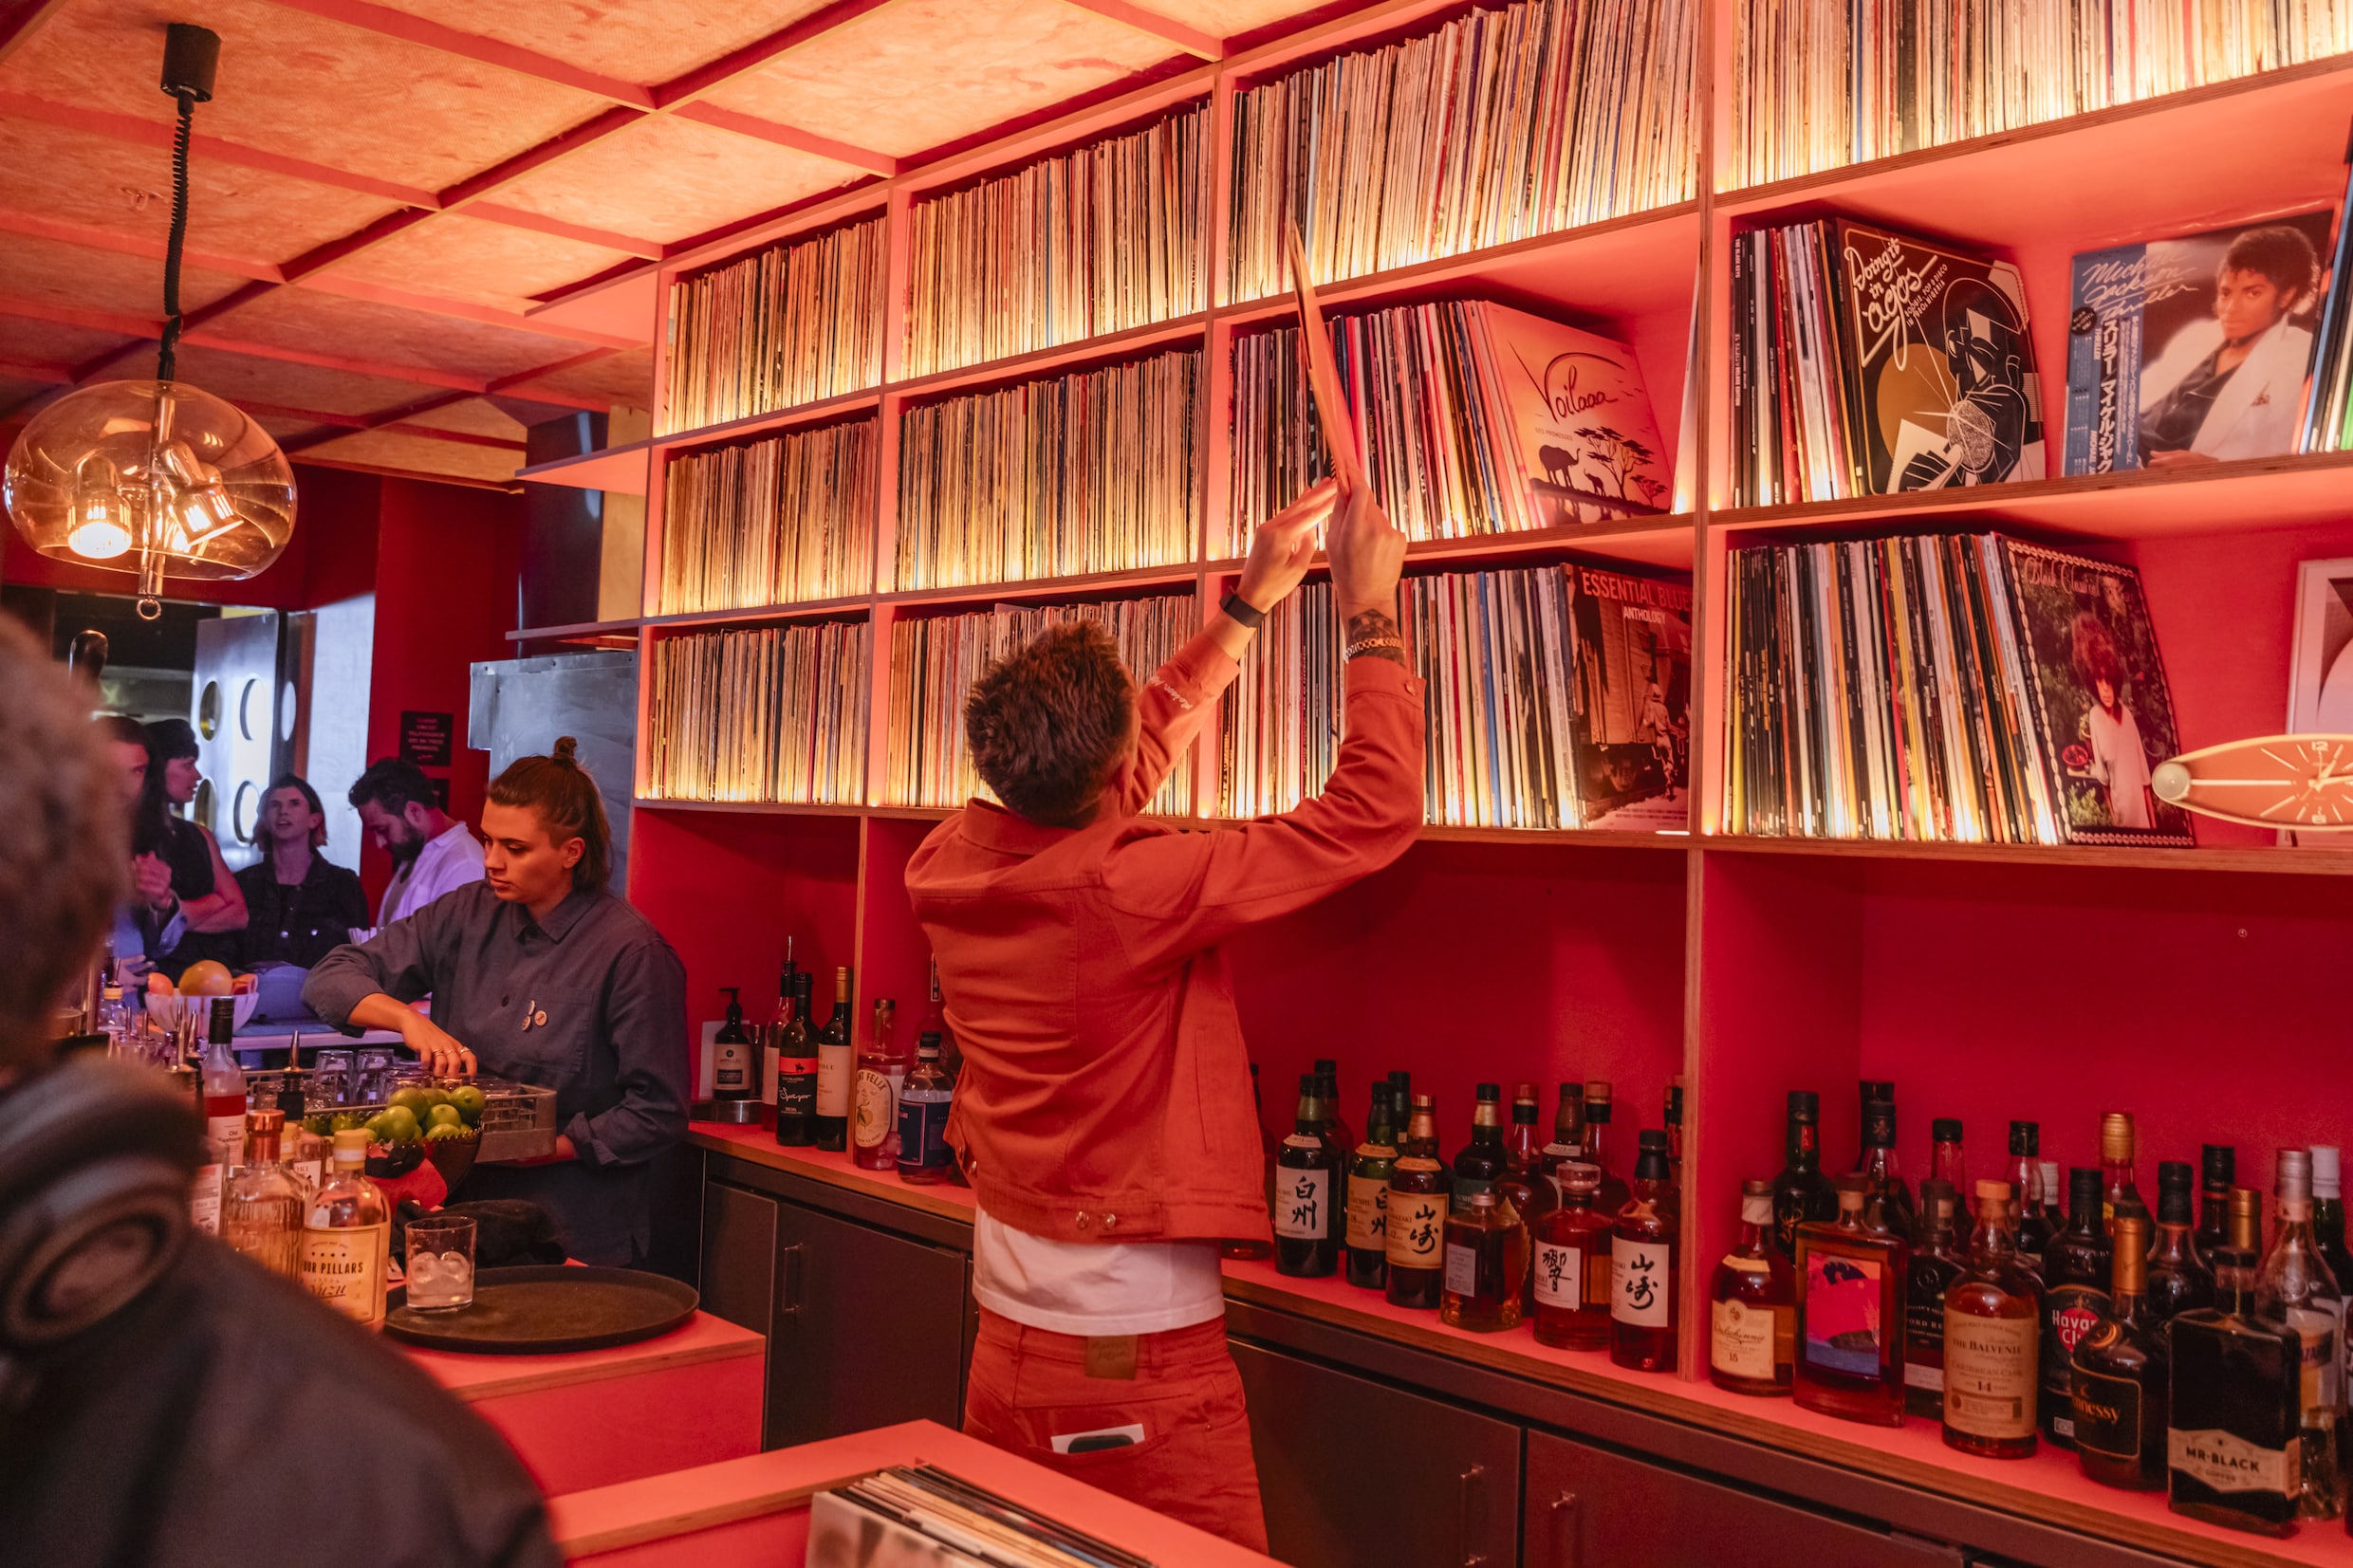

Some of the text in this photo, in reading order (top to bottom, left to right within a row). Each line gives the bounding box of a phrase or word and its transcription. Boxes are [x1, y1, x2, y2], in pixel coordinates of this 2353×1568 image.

[1843, 247, 1894, 291] Doing
[1926, 279, 1946, 304] NIGERIA
[1508, 341, 1627, 425] Voilaaa
[1582, 572, 1693, 612] ESSENTIAL BLUE
[1623, 606, 1666, 624] ANTHOLOGY
[2311, 741, 2328, 752] 12
[866, 1072, 887, 1092] FELIX
[1292, 1175, 1317, 1230] 白州
[303, 1260, 363, 1275] OUR PILLARS
[2051, 1309, 2099, 1328] Hava
[1953, 1337, 2022, 1355] THE BALVENIE
[1977, 1380, 1992, 1393] 14
[2072, 1396, 2120, 1425] nnessy
